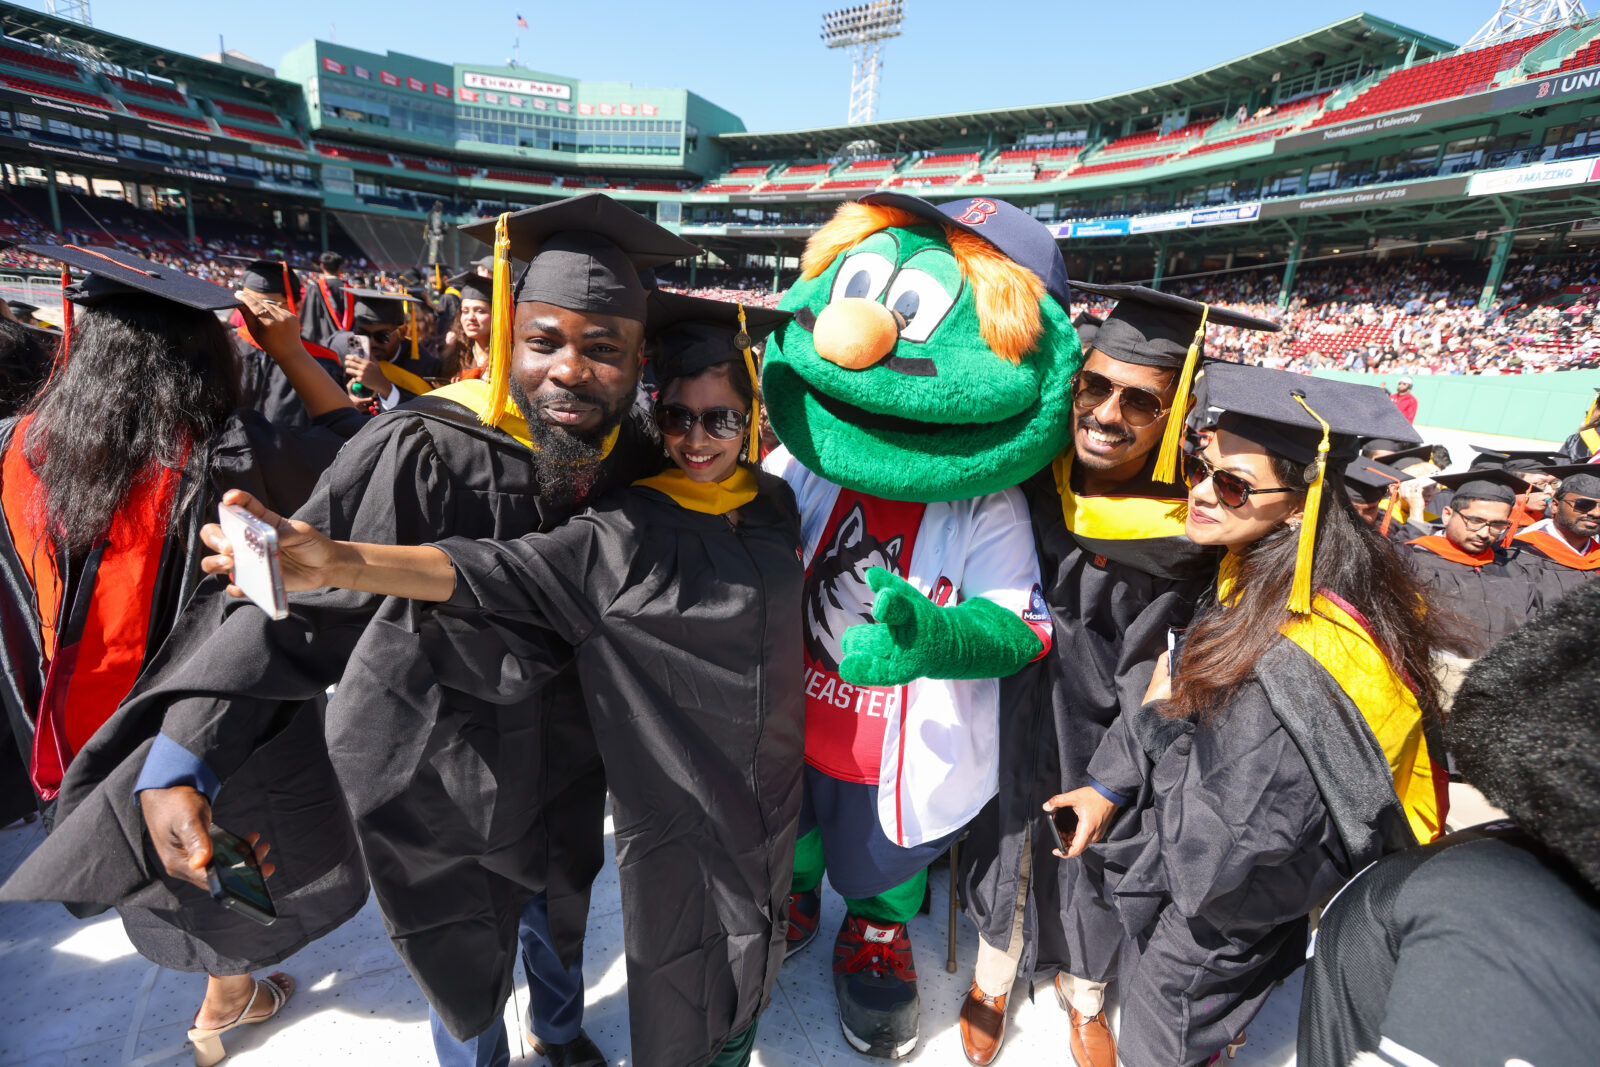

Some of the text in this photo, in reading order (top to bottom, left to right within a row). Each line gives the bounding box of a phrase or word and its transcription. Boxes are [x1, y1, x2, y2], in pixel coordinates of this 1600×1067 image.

[471, 75, 562, 94] FENWAY PARK
[1323, 112, 1423, 141] Northeastern University
[1516, 167, 1574, 184] AMAZING
[1298, 187, 1407, 209] Congratulations Class of 2025
[951, 197, 998, 226] B
